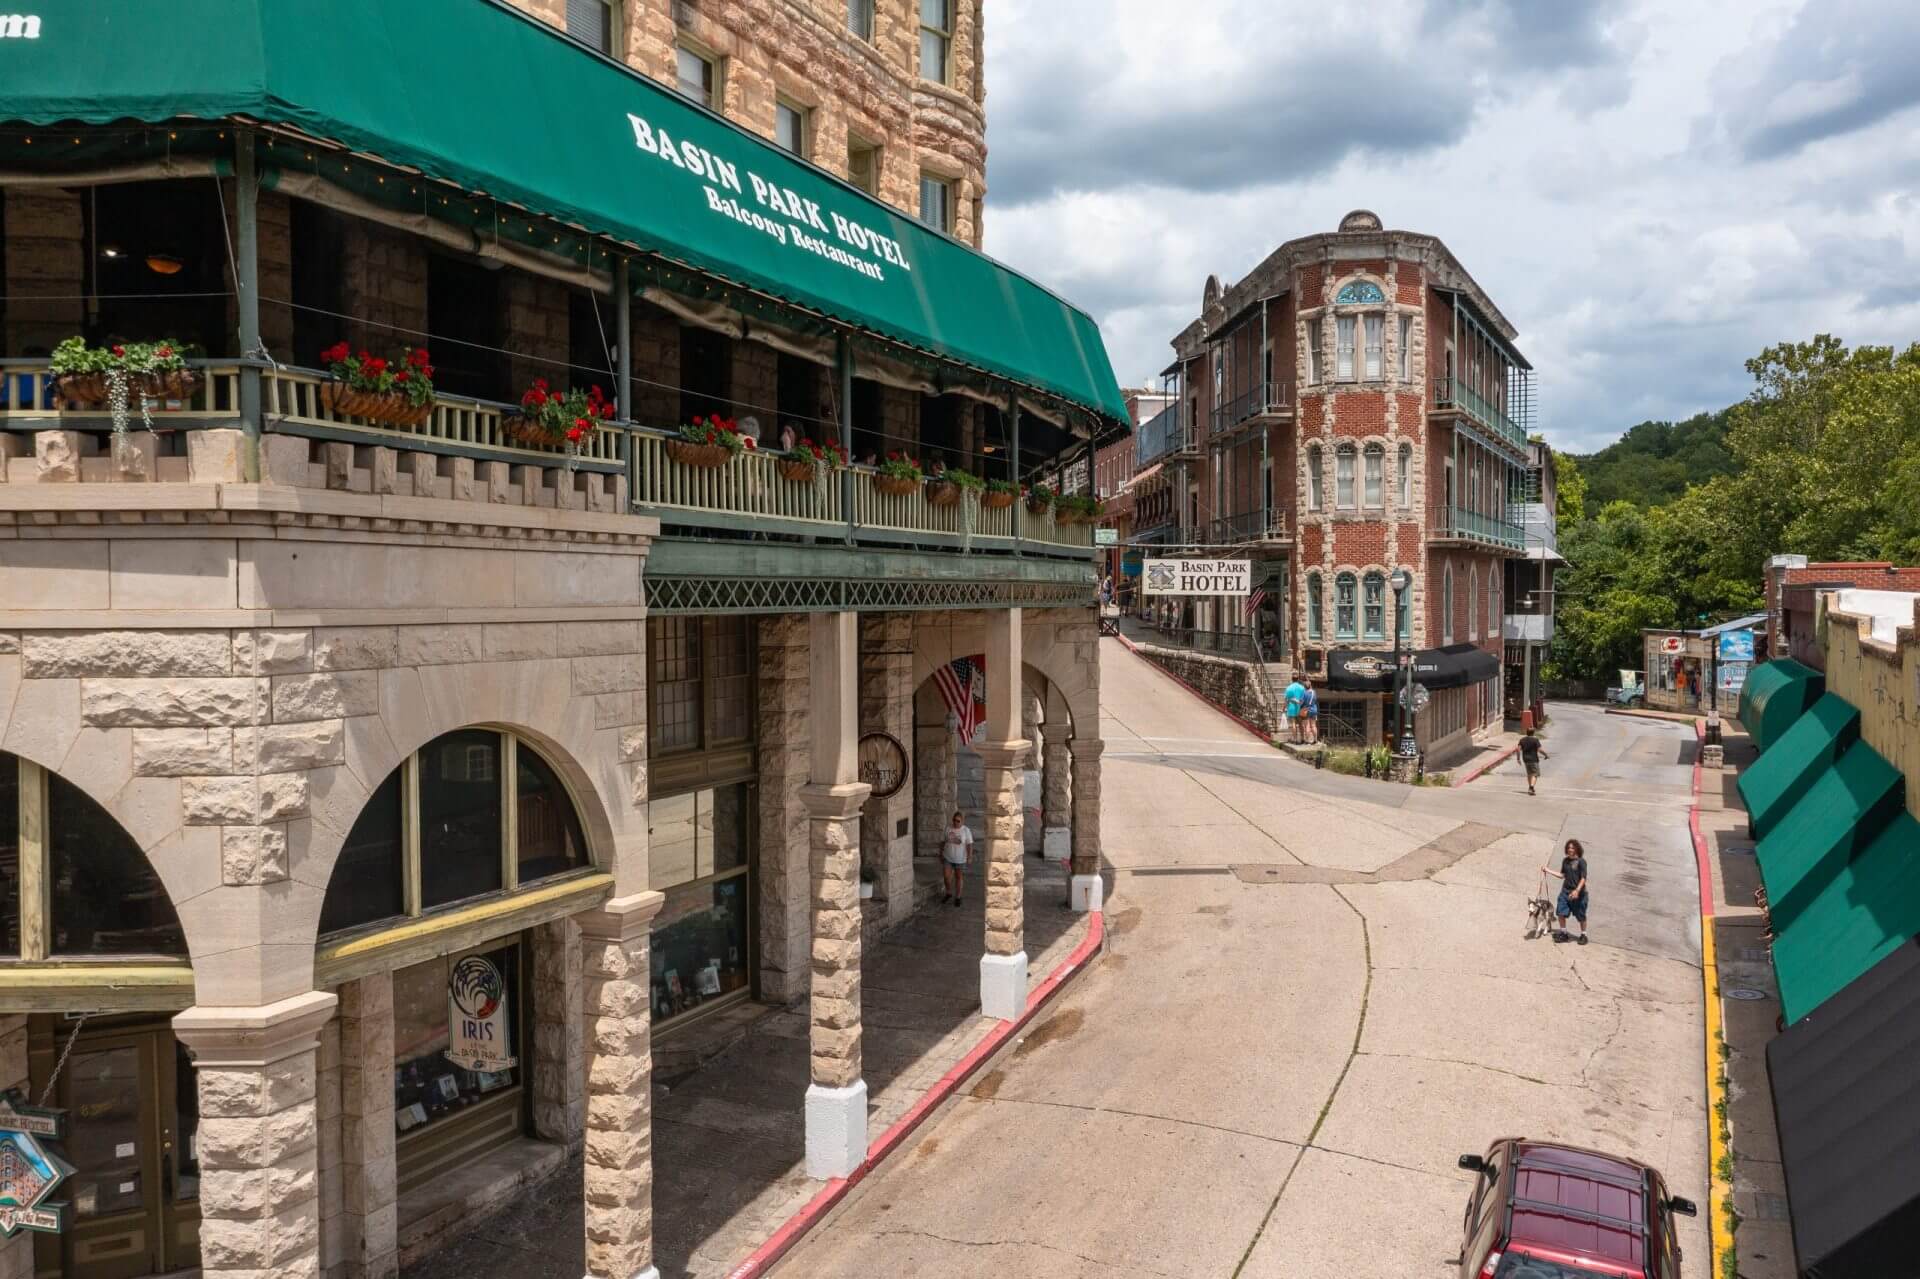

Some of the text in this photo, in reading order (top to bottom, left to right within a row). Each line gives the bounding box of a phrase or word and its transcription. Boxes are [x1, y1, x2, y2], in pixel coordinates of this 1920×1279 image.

[627, 112, 911, 271] BASIN PARK HOTEL
[703, 185, 885, 281] Balcony Restaurant
[1181, 561, 1247, 573] BASIN PARK
[1181, 575, 1247, 592] HOTEL
[462, 1020, 493, 1041] IRIS
